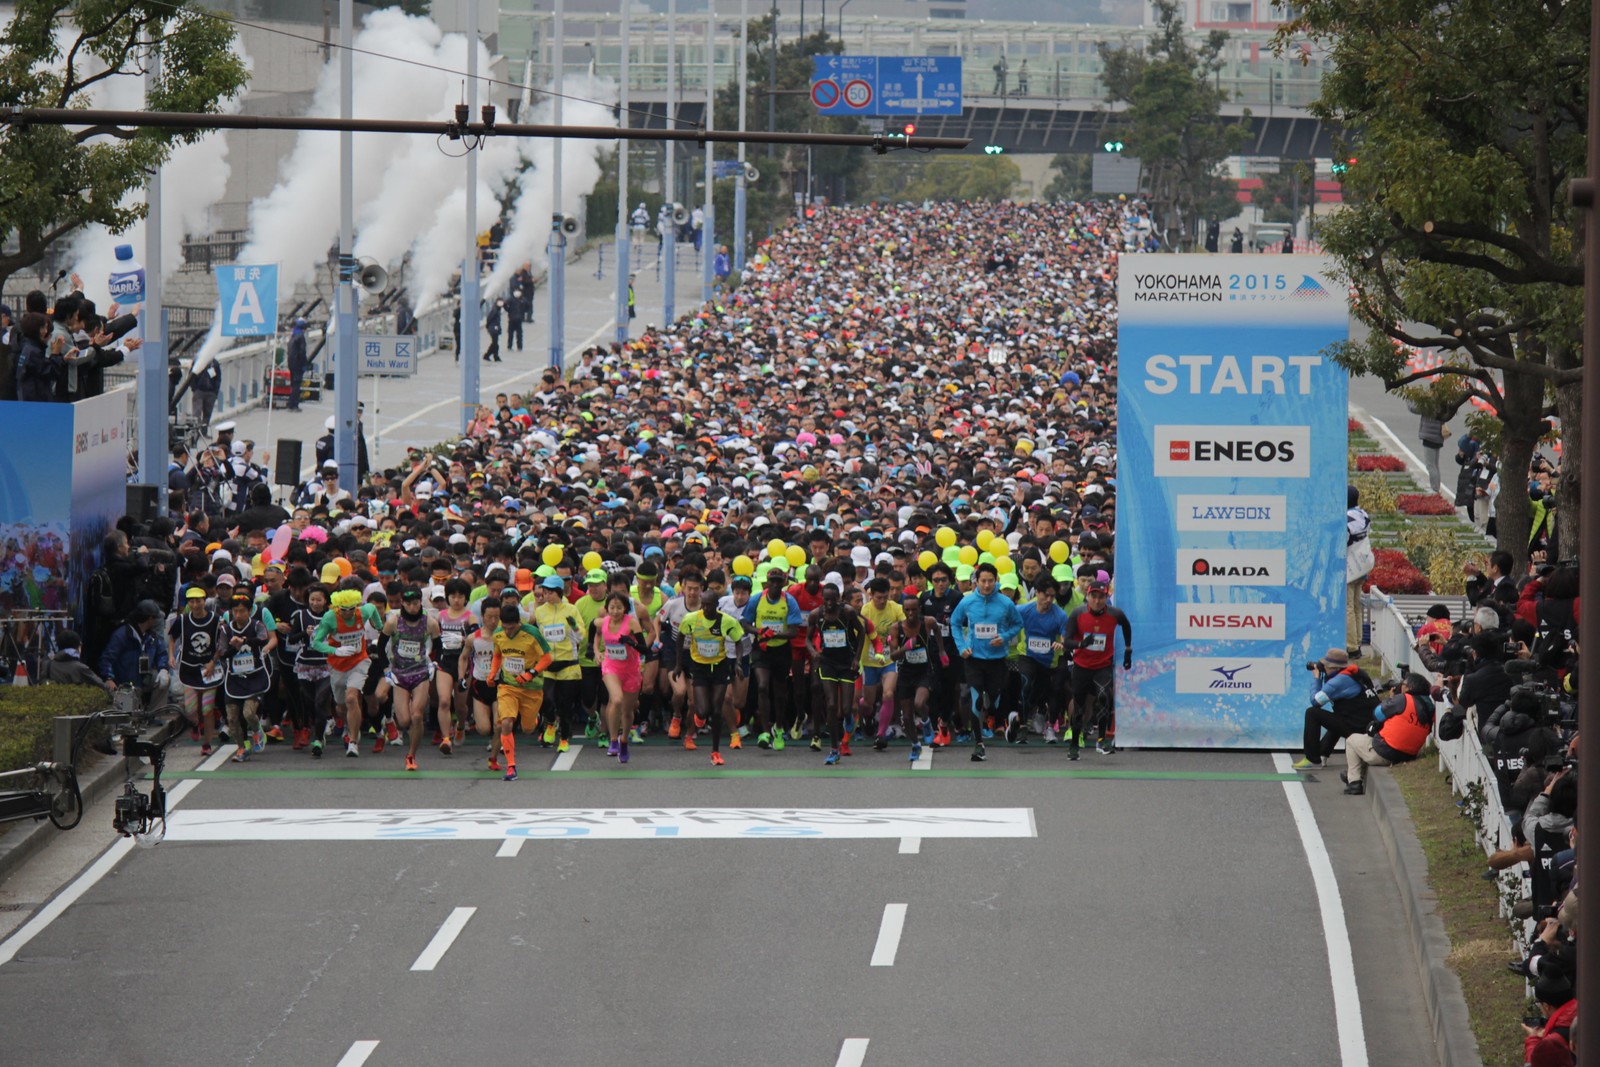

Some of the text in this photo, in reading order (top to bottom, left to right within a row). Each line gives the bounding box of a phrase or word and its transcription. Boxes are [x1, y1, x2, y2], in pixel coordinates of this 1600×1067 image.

[850, 87, 866, 100] 50
[1134, 274, 1286, 290] YOKOHAMA 2015
[1134, 292, 1222, 302] MARATHON
[367, 360, 409, 368] Nishi Ward
[1144, 354, 1322, 395] START
[1195, 440, 1295, 462] ENEOS
[1192, 507, 1271, 520] LAWSON
[1192, 558, 1270, 576] AMADA
[1189, 615, 1273, 628] NISSAN
[1029, 640, 1051, 649] ISEKI
[373, 826, 824, 838] 2015
